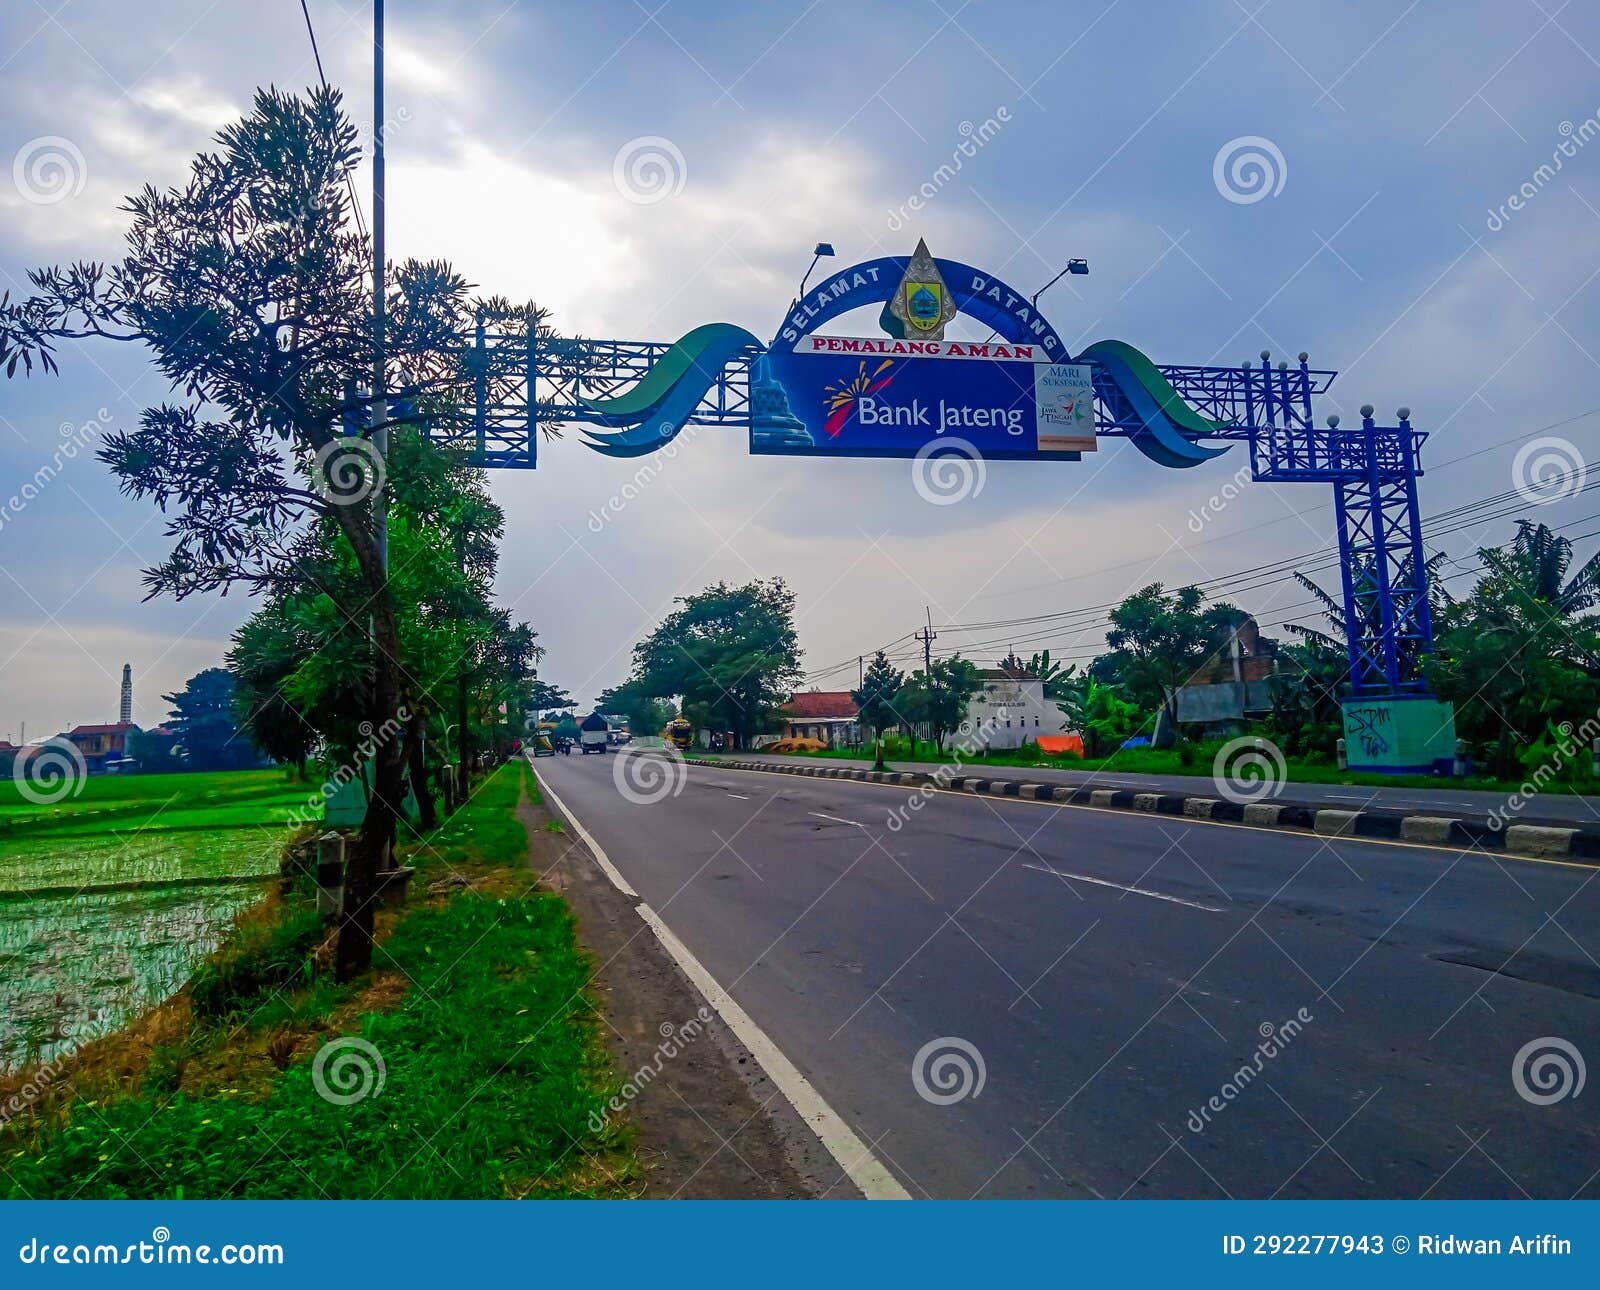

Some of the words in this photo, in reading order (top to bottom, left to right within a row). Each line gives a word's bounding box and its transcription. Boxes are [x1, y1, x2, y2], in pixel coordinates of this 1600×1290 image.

[782, 267, 880, 342] SELAMAT
[971, 276, 1056, 350] DATANG
[812, 337, 941, 355] PEMALANG
[945, 341, 1033, 359] AMAN
[1050, 366, 1080, 378] MARI
[858, 397, 931, 426] Bank
[935, 399, 1024, 436] Jateng
